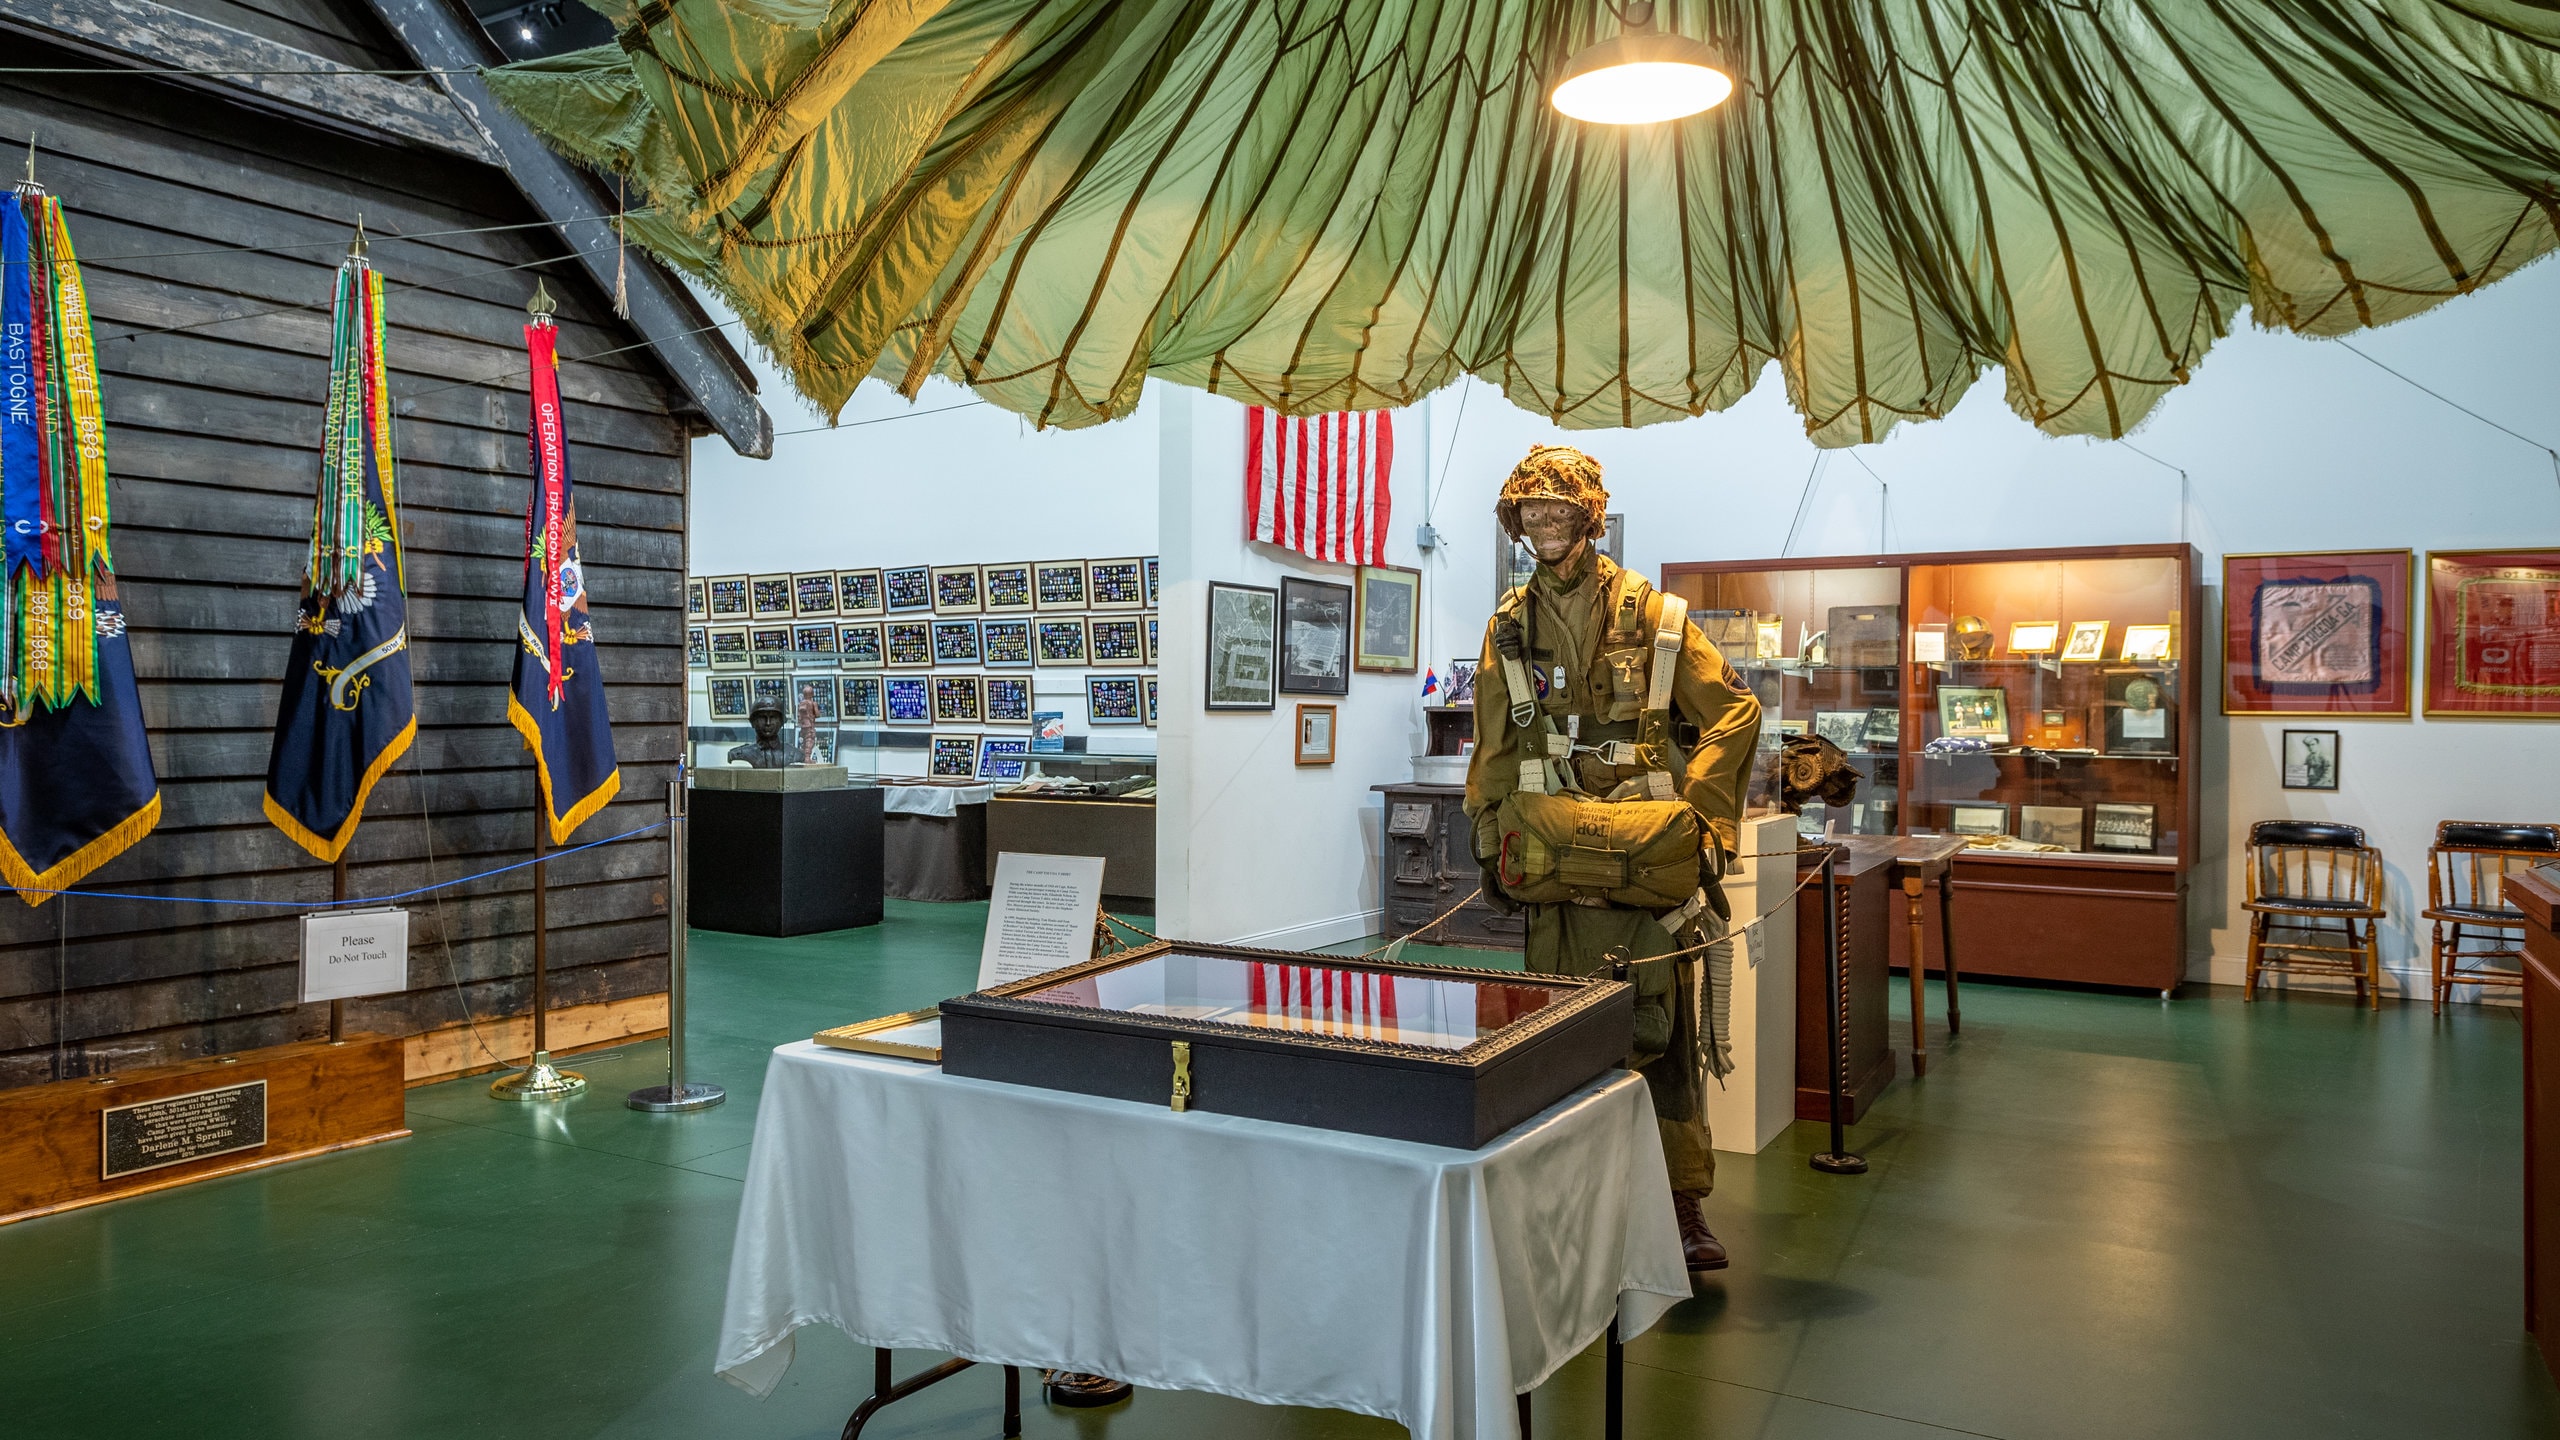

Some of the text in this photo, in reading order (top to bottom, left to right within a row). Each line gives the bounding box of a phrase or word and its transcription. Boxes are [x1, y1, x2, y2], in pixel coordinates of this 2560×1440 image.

[8, 323, 29, 425] BASTOGNE
[325, 378, 344, 469] NORMANDY
[346, 346, 360, 505] CENTRAL EUROPE
[541, 402, 559, 483] OPERATION
[31, 591, 49, 670] 1967-1968
[381, 640, 399, 654] 501st
[2272, 642, 2301, 671] CAMP
[1576, 821, 1609, 838] TOP
[341, 935, 375, 947] Please
[329, 950, 387, 964] Do Not Touch
[166, 1097, 199, 1110] regimental
[200, 1095, 215, 1103] flags
[215, 1090, 241, 1099] honoring
[144, 1104, 231, 1126] parachute infantry regiments
[155, 1121, 168, 1129] that
[185, 1113, 213, 1122] activated
[147, 1129, 166, 1137] Camp
[187, 1120, 208, 1129] during
[153, 1133, 169, 1141] been
[169, 1130, 187, 1139] given
[206, 1121, 230, 1131] memory
[141, 1129, 233, 1154] Darlene M. Spratlin
